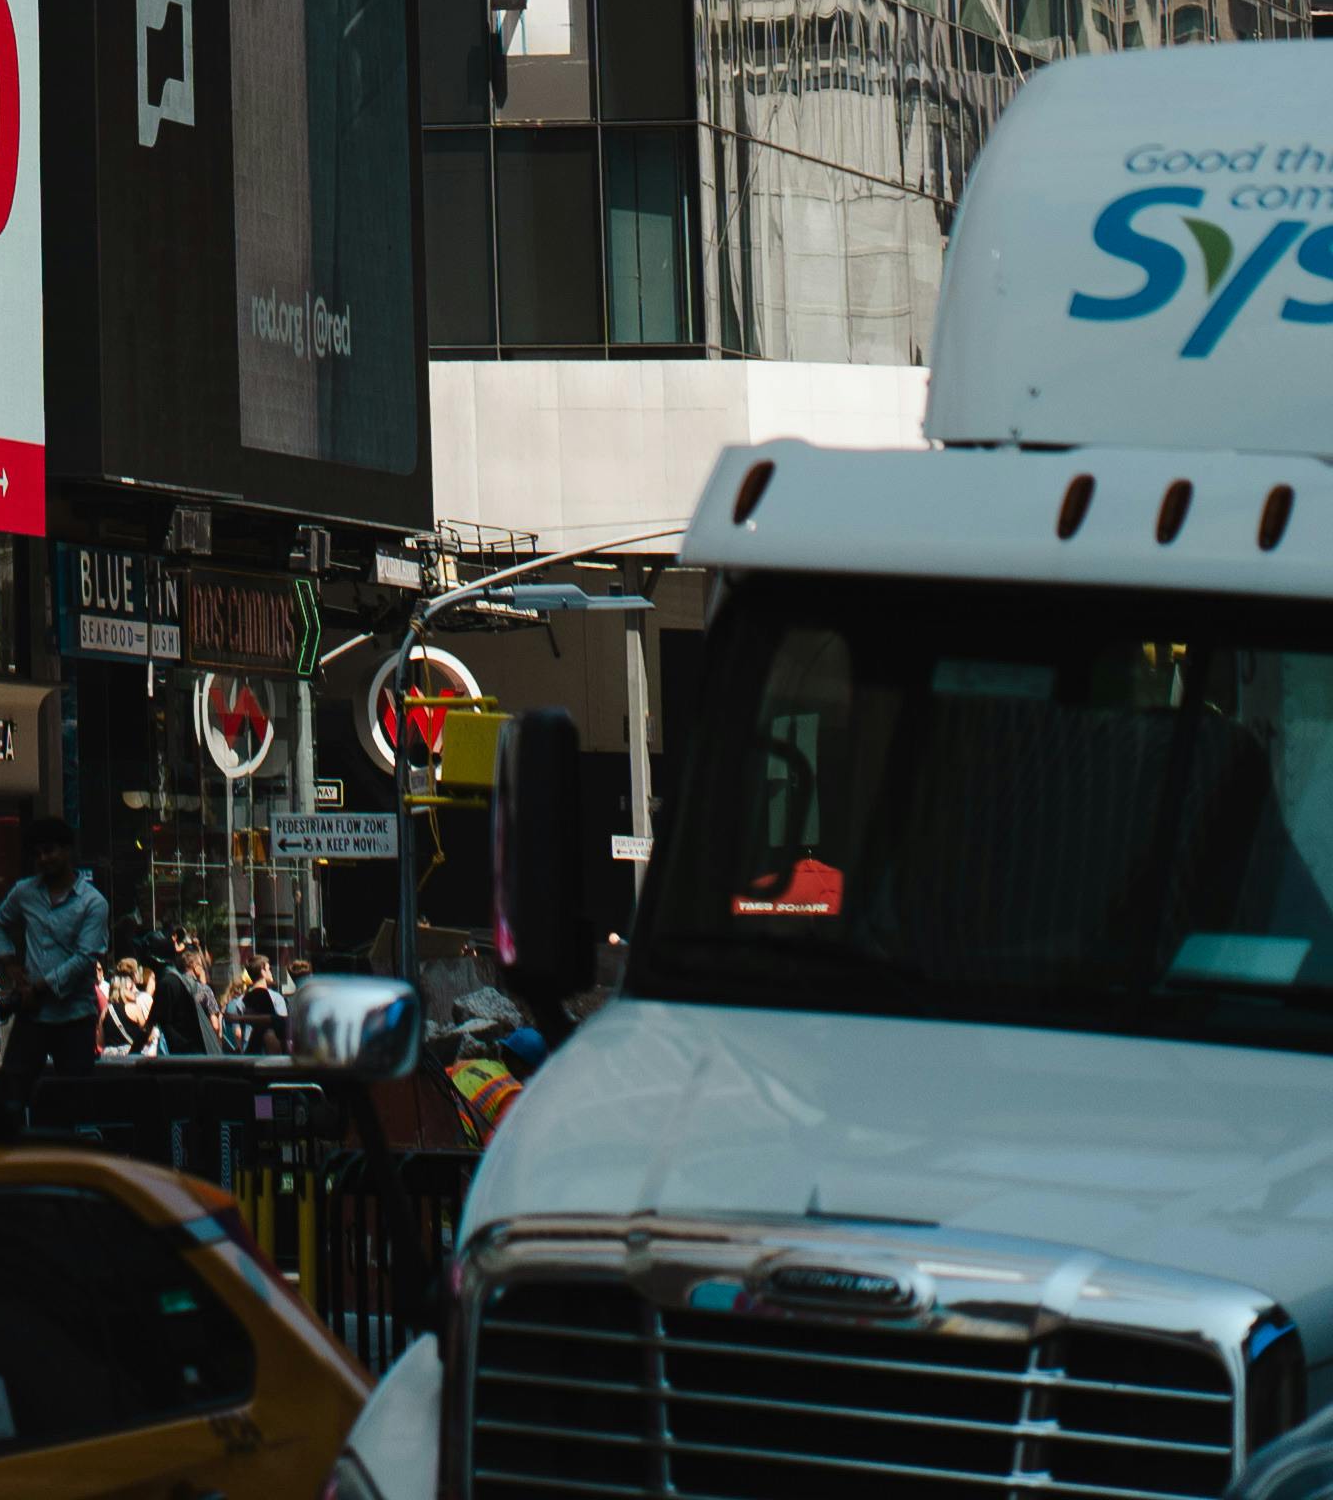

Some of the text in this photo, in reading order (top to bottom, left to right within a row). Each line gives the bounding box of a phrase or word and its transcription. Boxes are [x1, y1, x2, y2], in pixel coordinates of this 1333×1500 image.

[1124, 142, 1267, 175] Good
[80, 550, 133, 613] BLUE
[81, 617, 181, 653] SEAFOOD USHI
[276, 819, 389, 834] PEDESTRIAN FLOW ZONE
[326, 837, 350, 851] KEEP
